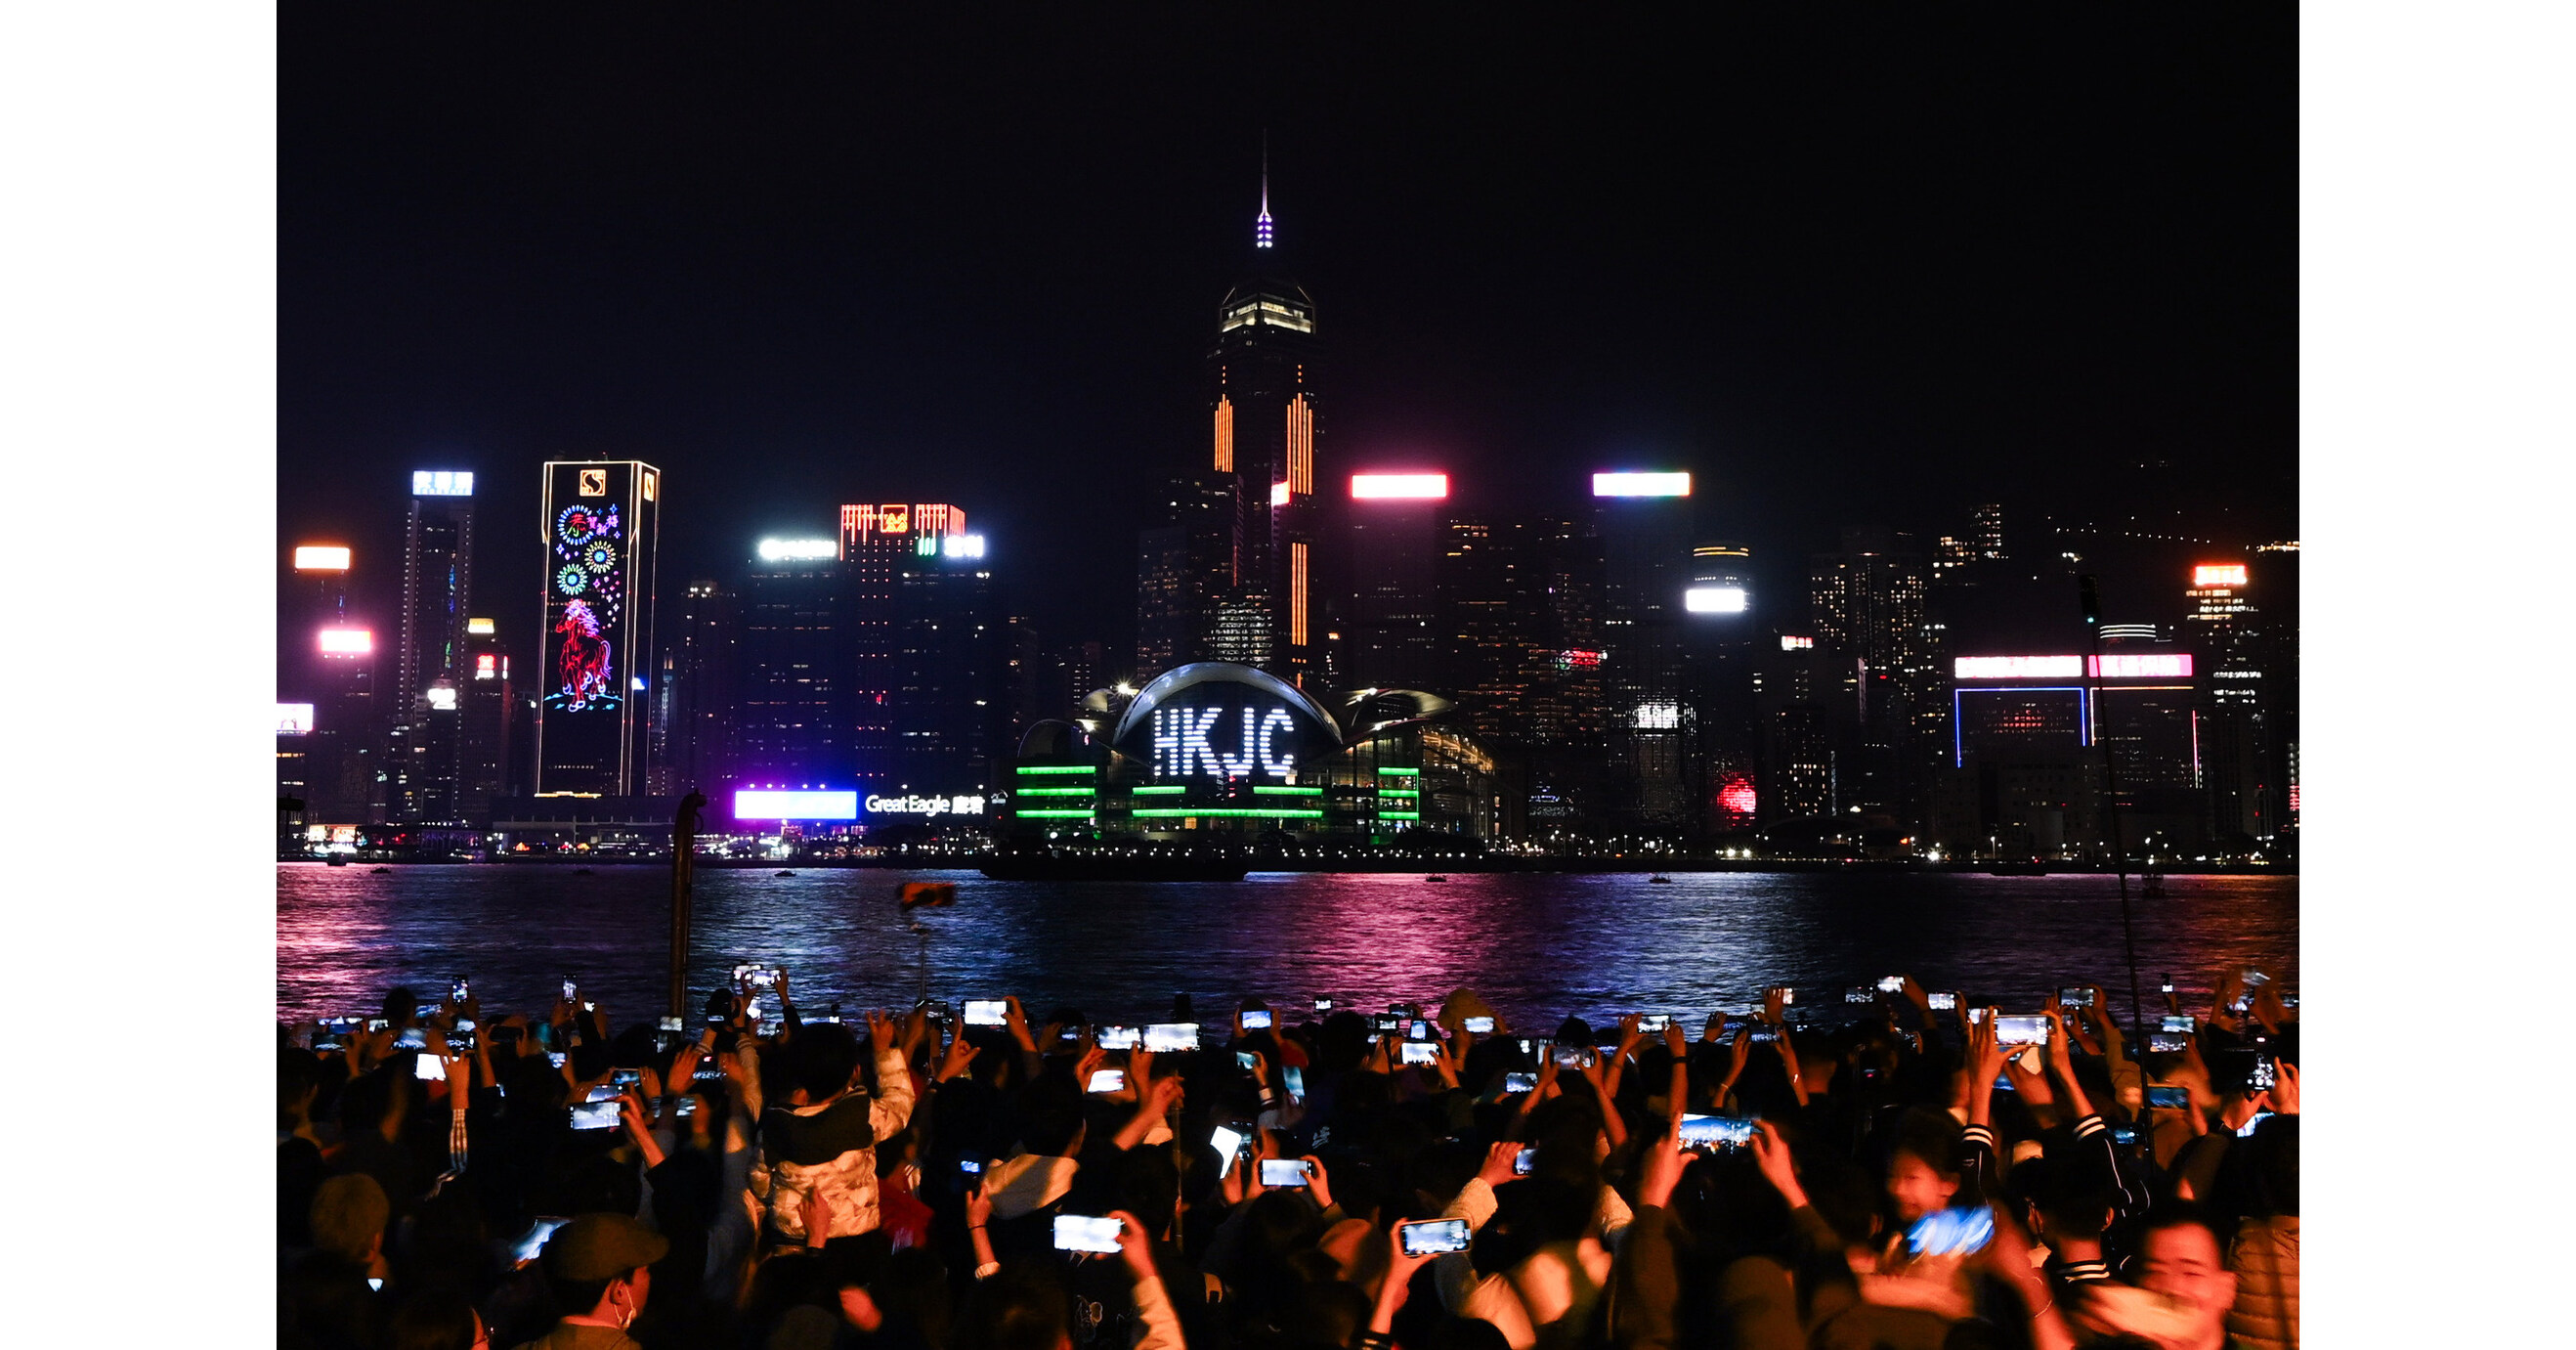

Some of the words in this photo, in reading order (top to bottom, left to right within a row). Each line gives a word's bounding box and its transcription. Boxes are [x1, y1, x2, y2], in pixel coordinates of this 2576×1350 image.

[1154, 708, 1295, 776] HKJC
[865, 794, 908, 813] Great
[909, 794, 951, 817] Eagle
